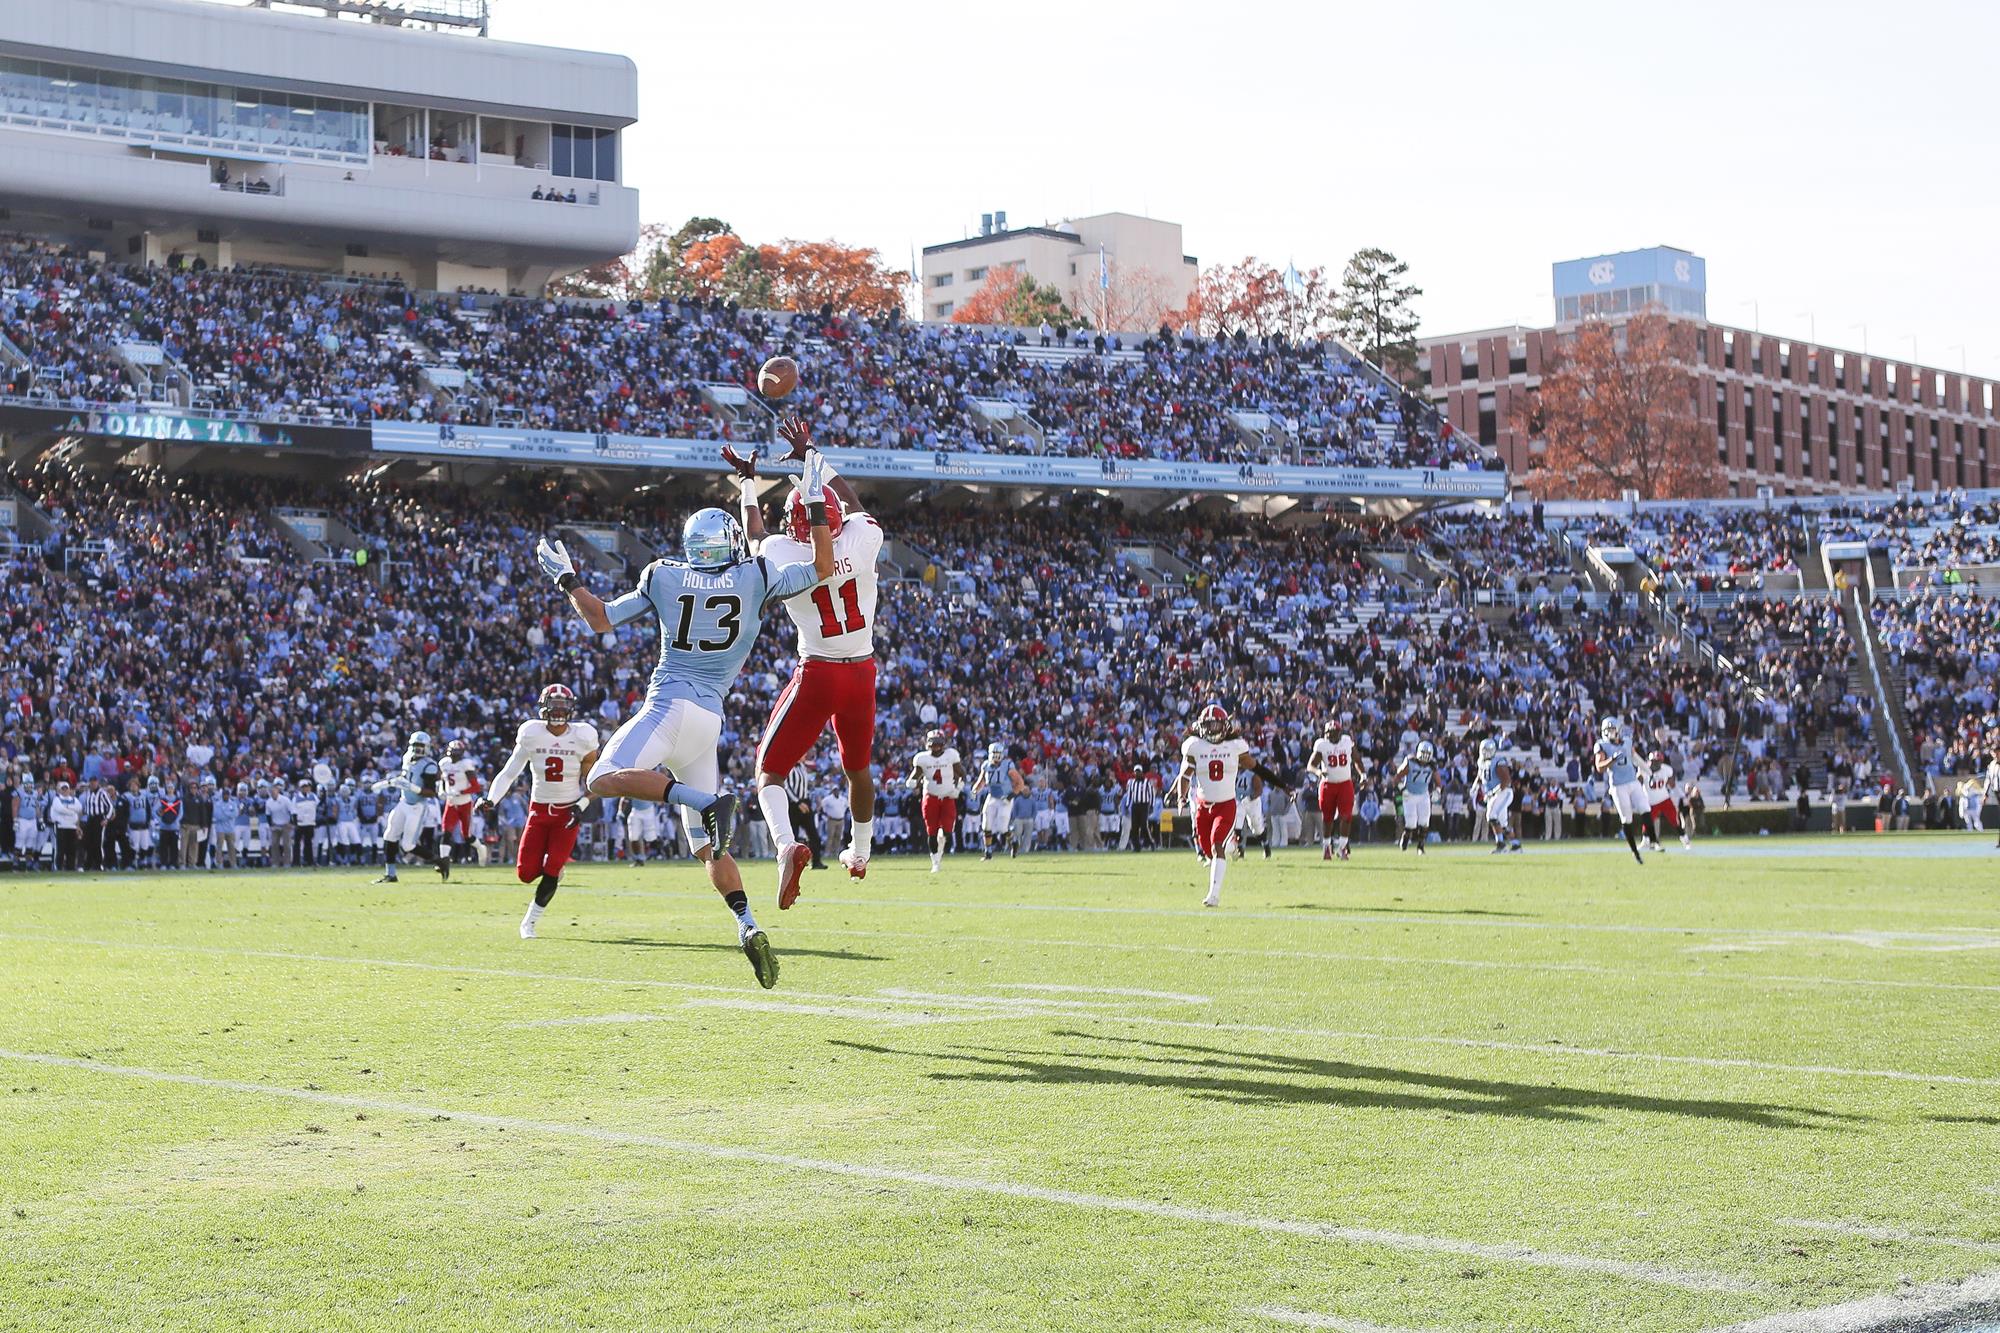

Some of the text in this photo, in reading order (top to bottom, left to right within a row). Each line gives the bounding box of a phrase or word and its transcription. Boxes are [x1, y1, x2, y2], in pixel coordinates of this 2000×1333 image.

[56, 412, 194, 441] AROLINA
[439, 425, 456, 441] 85
[439, 439, 482, 450] LACEY
[595, 435, 609, 450] 10
[593, 448, 652, 460] TALBOTT
[935, 452, 949, 467] 62
[845, 462, 881, 470] PEACH
[935, 466, 986, 476] RUSNAK
[1001, 469, 1077, 478] LIBERTY BOWL
[1239, 465, 1254, 479] 44
[1422, 471, 1436, 484] 71
[682, 571, 734, 589] HOLLINS
[810, 578, 867, 639] 11
[671, 593, 742, 653] 13
[544, 756, 564, 782] 2
[1208, 759, 1224, 782] 8
[1412, 769, 1431, 784] 77
[932, 769, 943, 785] 4
